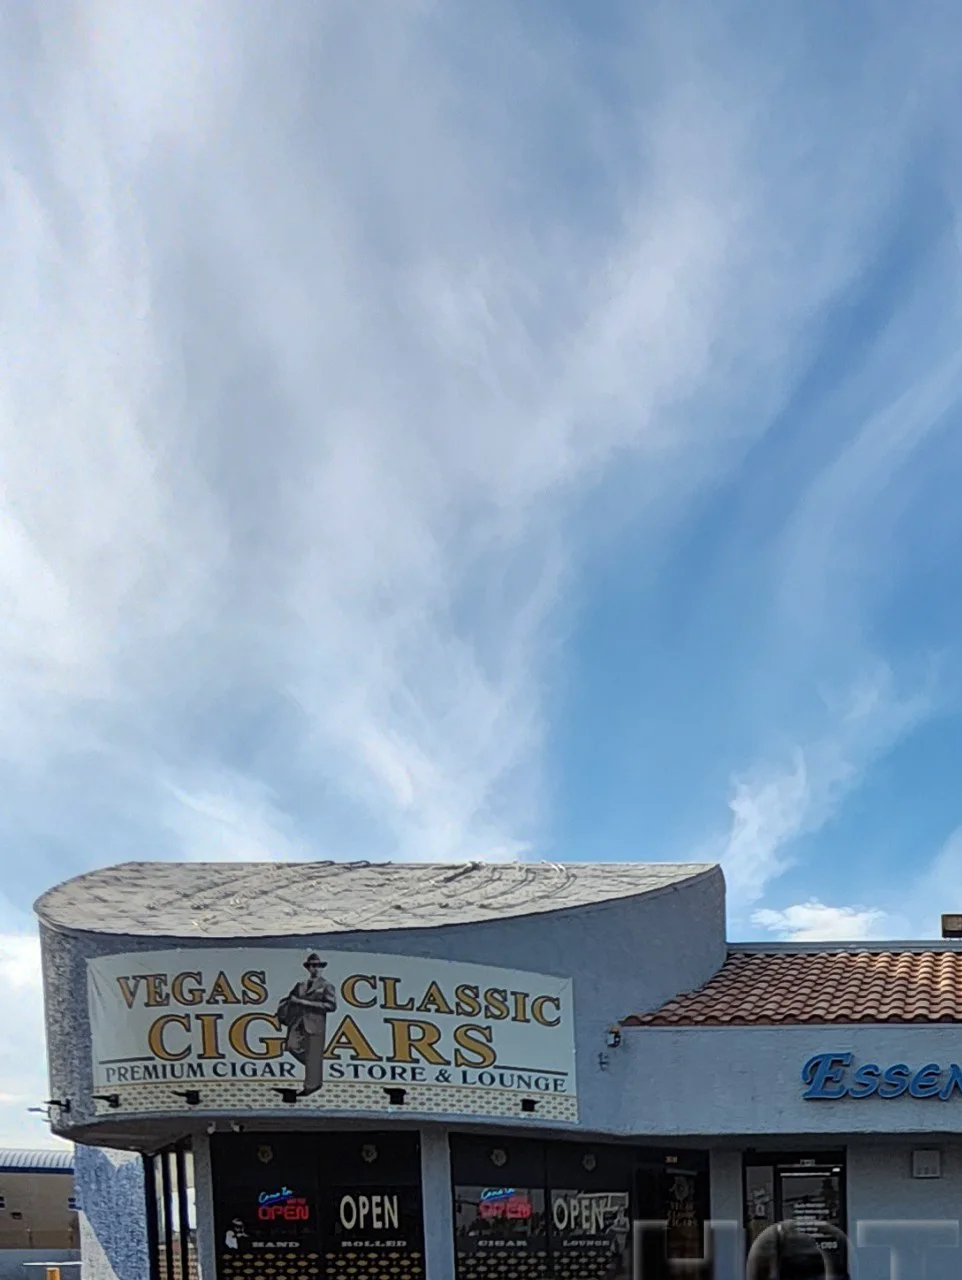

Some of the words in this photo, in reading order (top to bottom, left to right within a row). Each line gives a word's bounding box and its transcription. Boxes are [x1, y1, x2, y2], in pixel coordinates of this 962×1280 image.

[117, 970, 268, 1009] VEGAS
[340, 974, 561, 1027] CLASSIC
[149, 1012, 497, 1068] CIGARS
[106, 1061, 205, 1083] PREMIUM
[212, 1061, 296, 1079] CIGAR
[329, 1063, 427, 1082] STORE
[434, 1068, 452, 1083] &
[461, 1070, 567, 1093] LOUNGE
[258, 1204, 310, 1221] OPEN
[340, 1195, 399, 1229] OPEN
[479, 1201, 533, 1219] OPEN
[553, 1198, 605, 1234] OPEN
